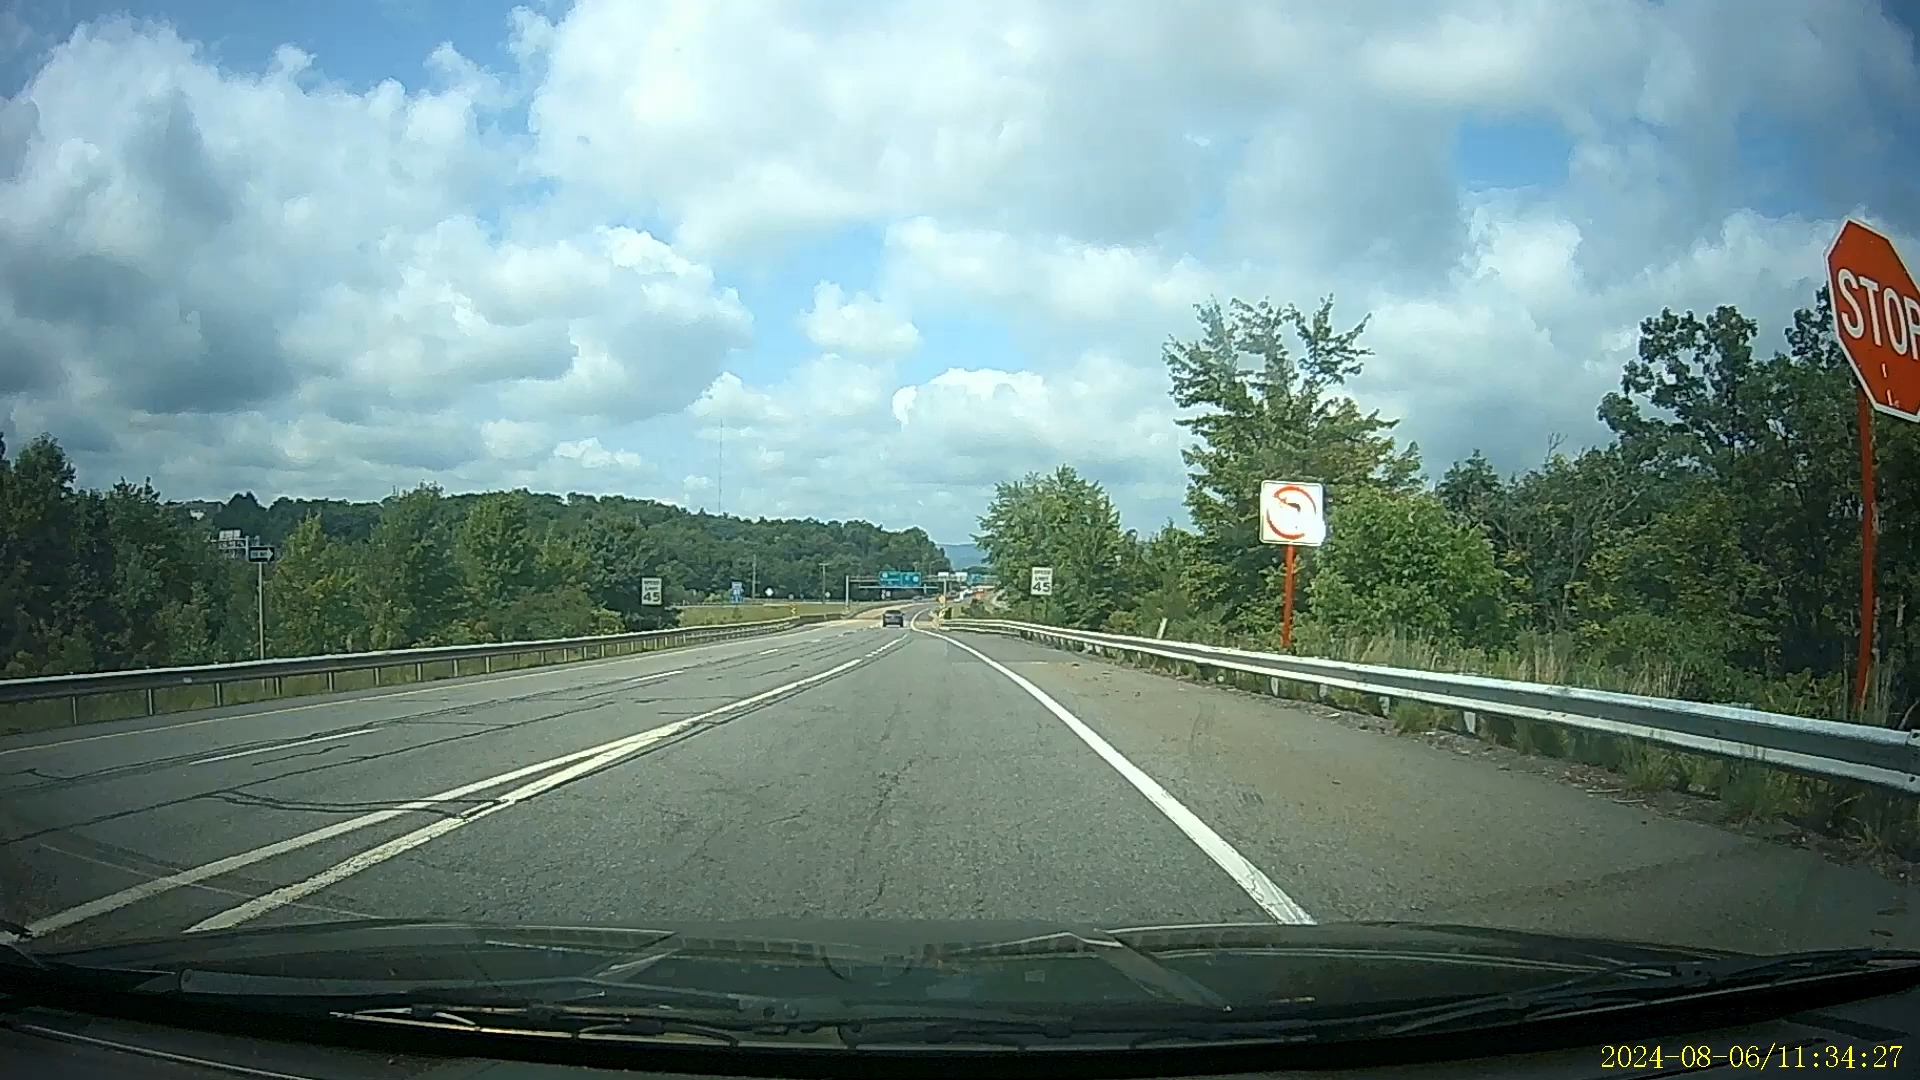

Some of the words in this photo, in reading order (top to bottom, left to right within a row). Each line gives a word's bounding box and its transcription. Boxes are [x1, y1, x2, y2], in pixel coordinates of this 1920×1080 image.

[1837, 268, 1920, 361] STOP
[1032, 581, 1050, 592] 45
[643, 591, 660, 602] 45
